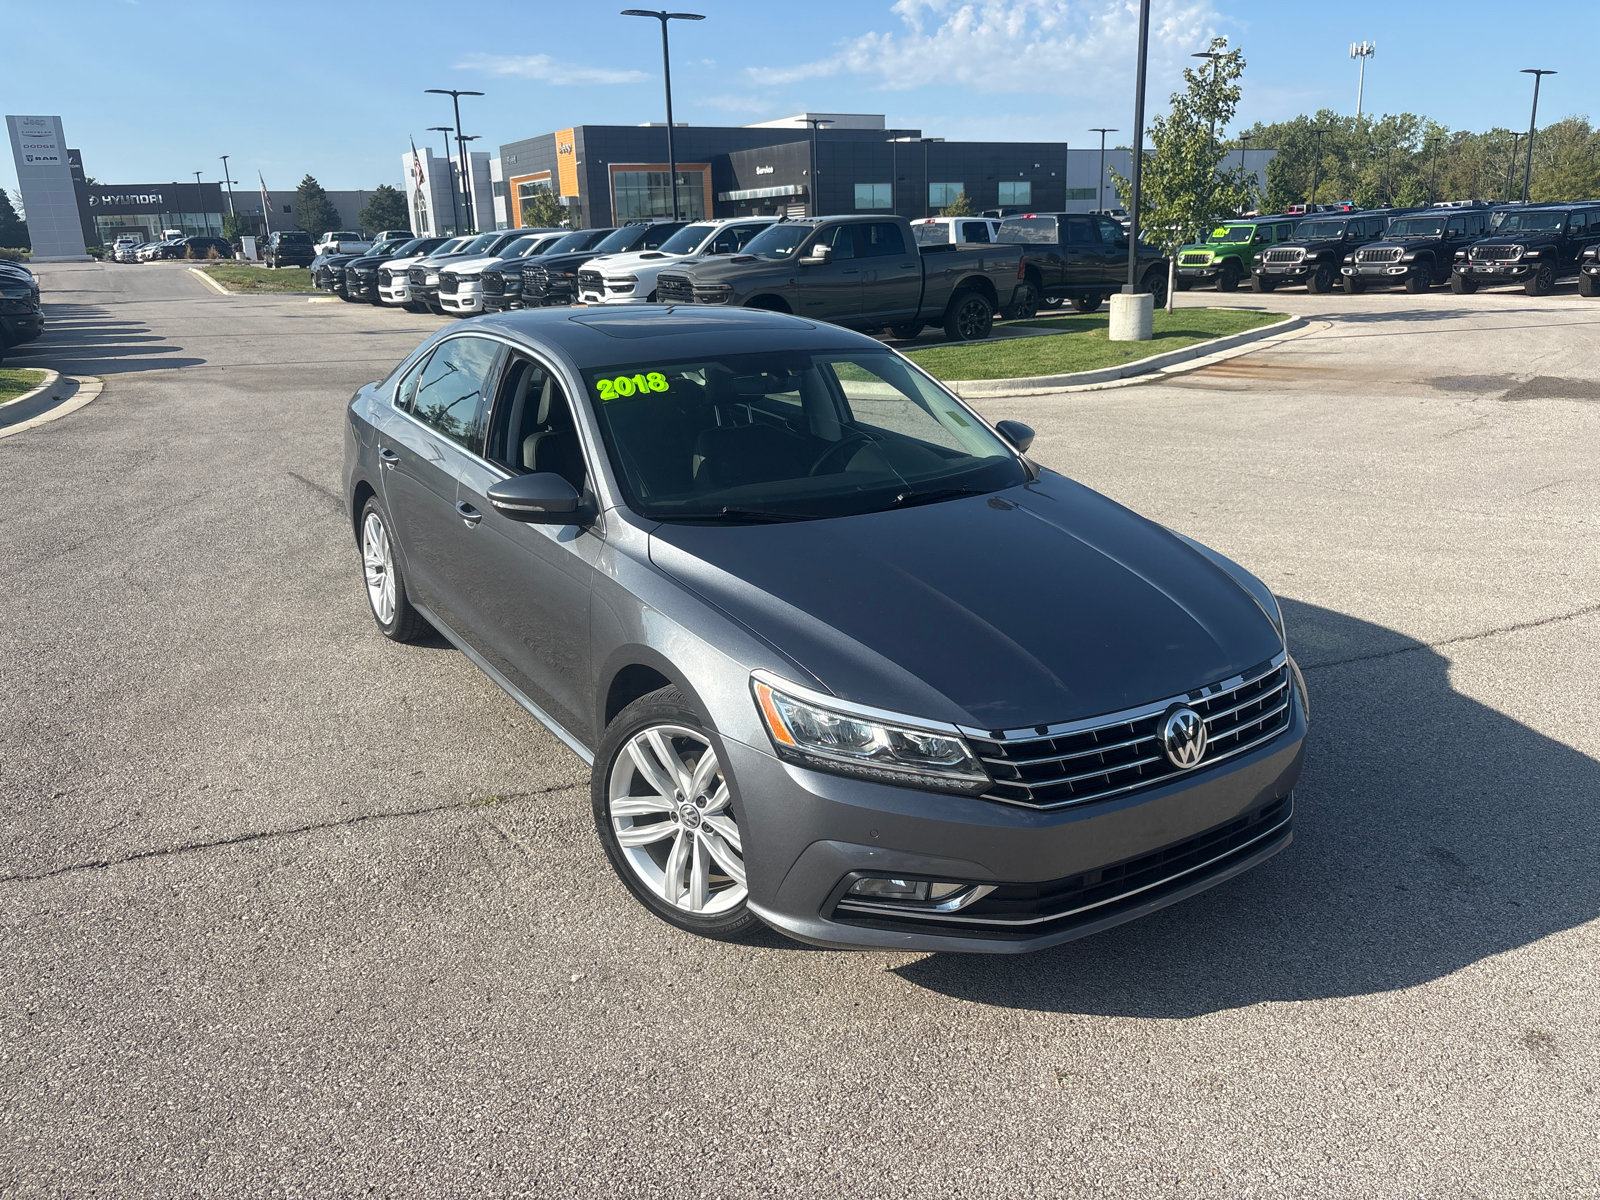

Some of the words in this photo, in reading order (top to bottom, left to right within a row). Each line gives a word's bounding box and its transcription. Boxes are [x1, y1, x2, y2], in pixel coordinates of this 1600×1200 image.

[23, 117, 46, 127] Jeep
[756, 165, 774, 175] Service
[102, 194, 163, 206] HYUNDAI
[596, 372, 669, 401] 2018
